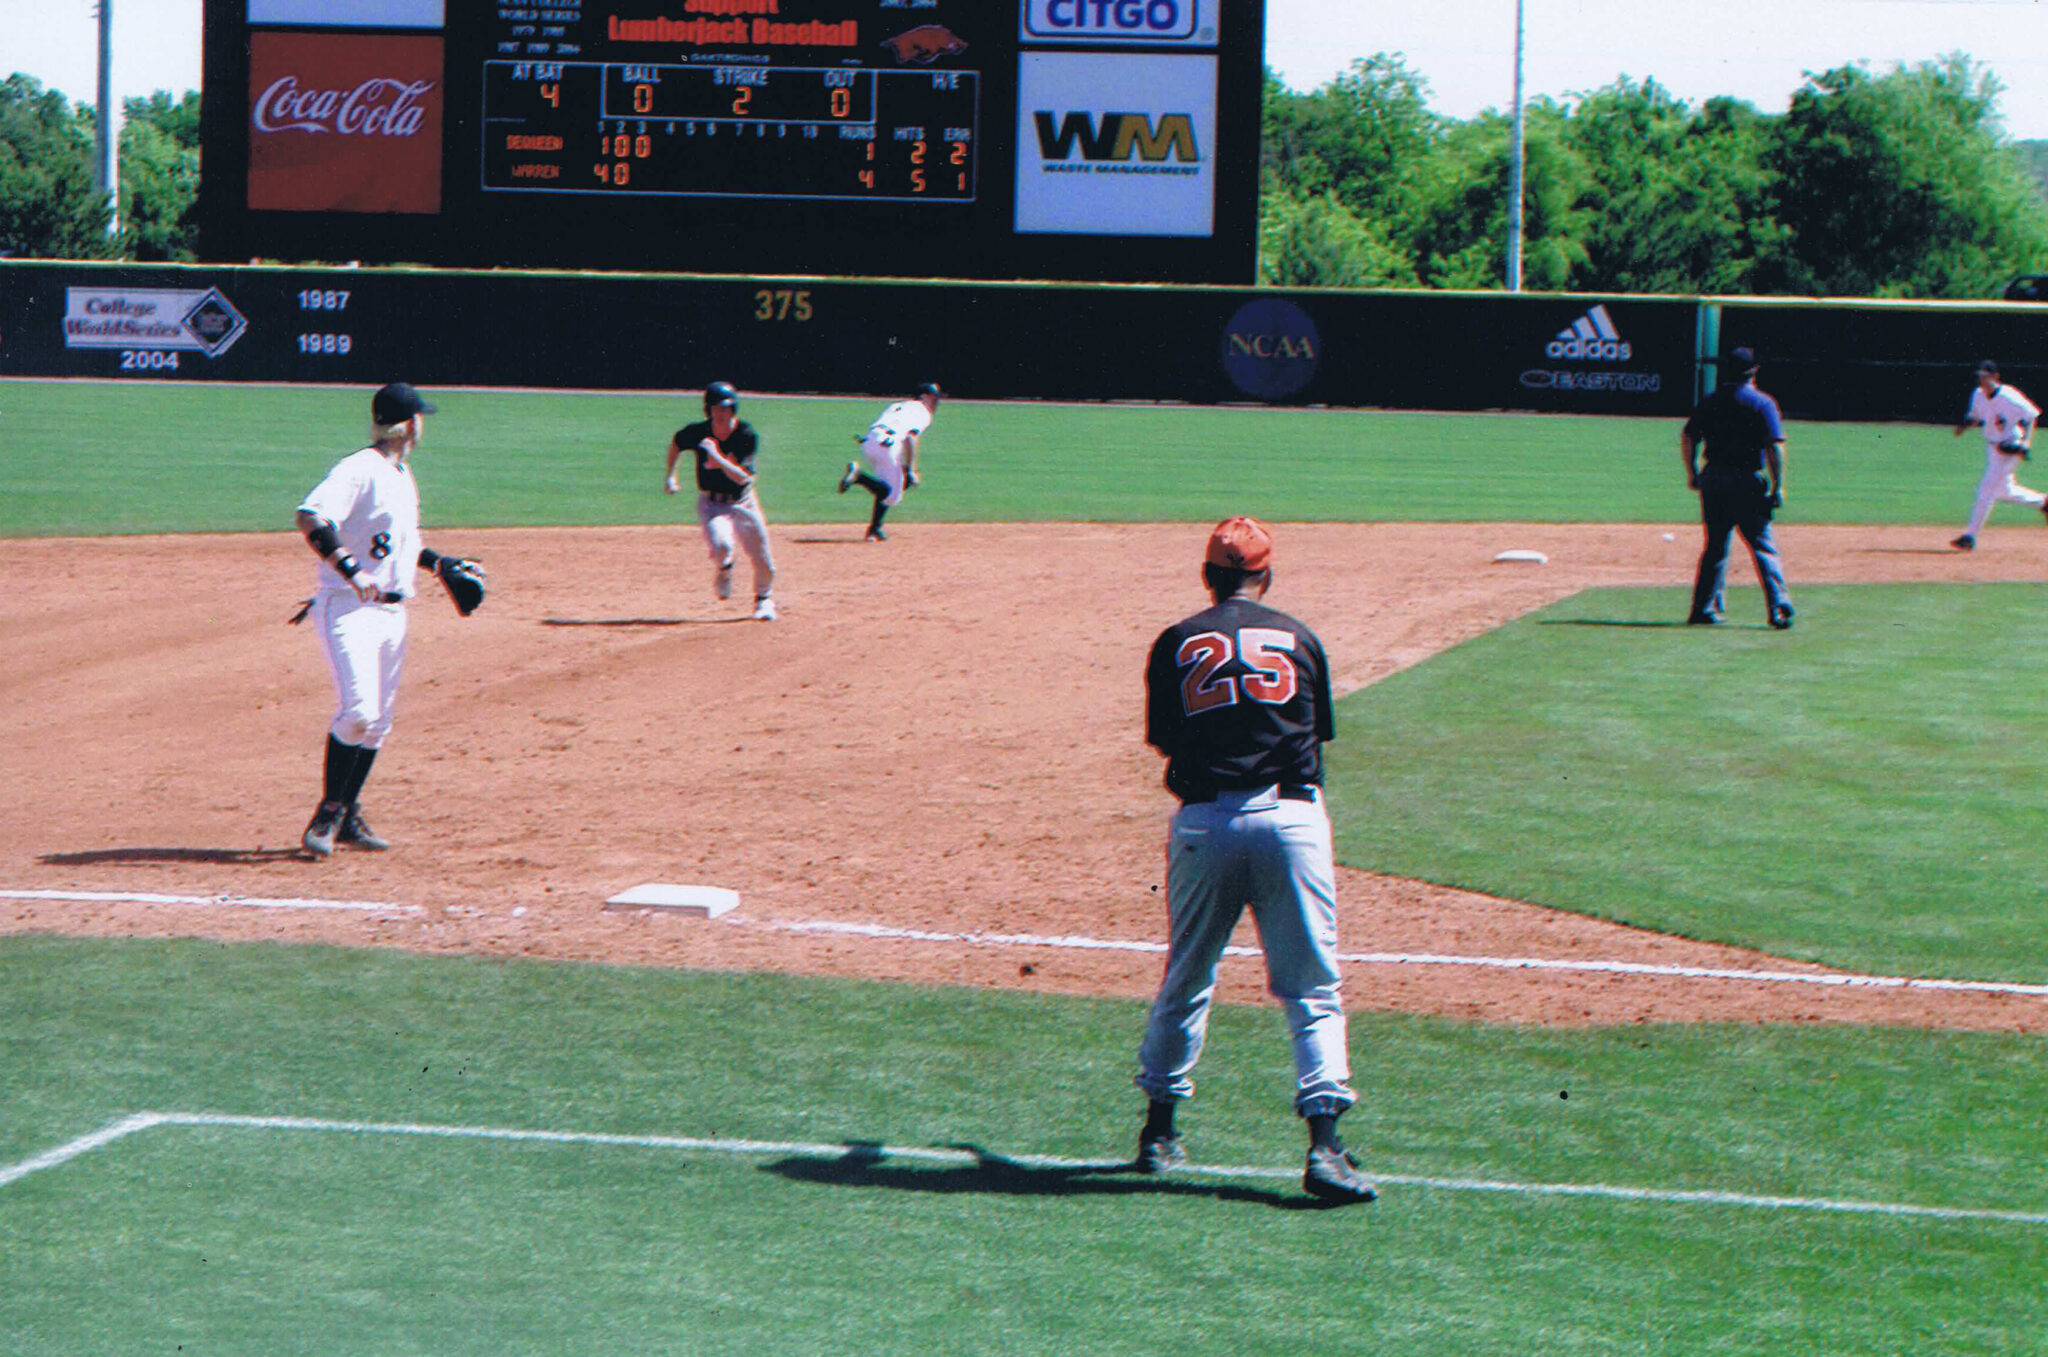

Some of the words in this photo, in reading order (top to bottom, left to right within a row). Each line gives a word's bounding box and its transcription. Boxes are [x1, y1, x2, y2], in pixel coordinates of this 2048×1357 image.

[1046, 0, 1179, 30] CITGO
[608, 15, 748, 44] Lumberjack
[752, 18, 857, 46] Baseball
[512, 65, 530, 80] AT
[535, 65, 563, 80] BAT
[622, 66, 661, 82] BALL
[713, 69, 768, 86] STRIKE
[824, 71, 856, 87] OUT
[253, 75, 436, 136] Coca-Cola
[541, 83, 559, 108] 4
[634, 83, 652, 112] 0
[733, 86, 751, 114] 2
[831, 88, 850, 117] 0
[616, 120, 627, 133] 2
[636, 121, 647, 134] 3
[665, 121, 675, 135] 4
[803, 125, 819, 138] 10
[838, 125, 877, 140] RUNS
[893, 126, 926, 141] HITS
[1033, 110, 1198, 162] WM
[866, 141, 875, 161] 1
[911, 141, 926, 164] 2
[951, 142, 967, 165] 2
[511, 163, 560, 179] WARREN
[859, 169, 875, 189] 4
[911, 168, 926, 192] 5
[958, 171, 966, 190] 1
[1042, 163, 1092, 174] WASTE
[1095, 164, 1200, 176] MANAGEMENT
[85, 298, 156, 317] College
[297, 290, 351, 311] 1987
[754, 288, 813, 321] 375
[297, 334, 352, 355] 1989
[1229, 333, 1315, 359] NCAA
[1545, 339, 1632, 361] adidas
[120, 351, 180, 371] 2004
[1552, 370, 1661, 392] EASTON
[369, 529, 392, 560] 8
[1176, 627, 1298, 716] 25
